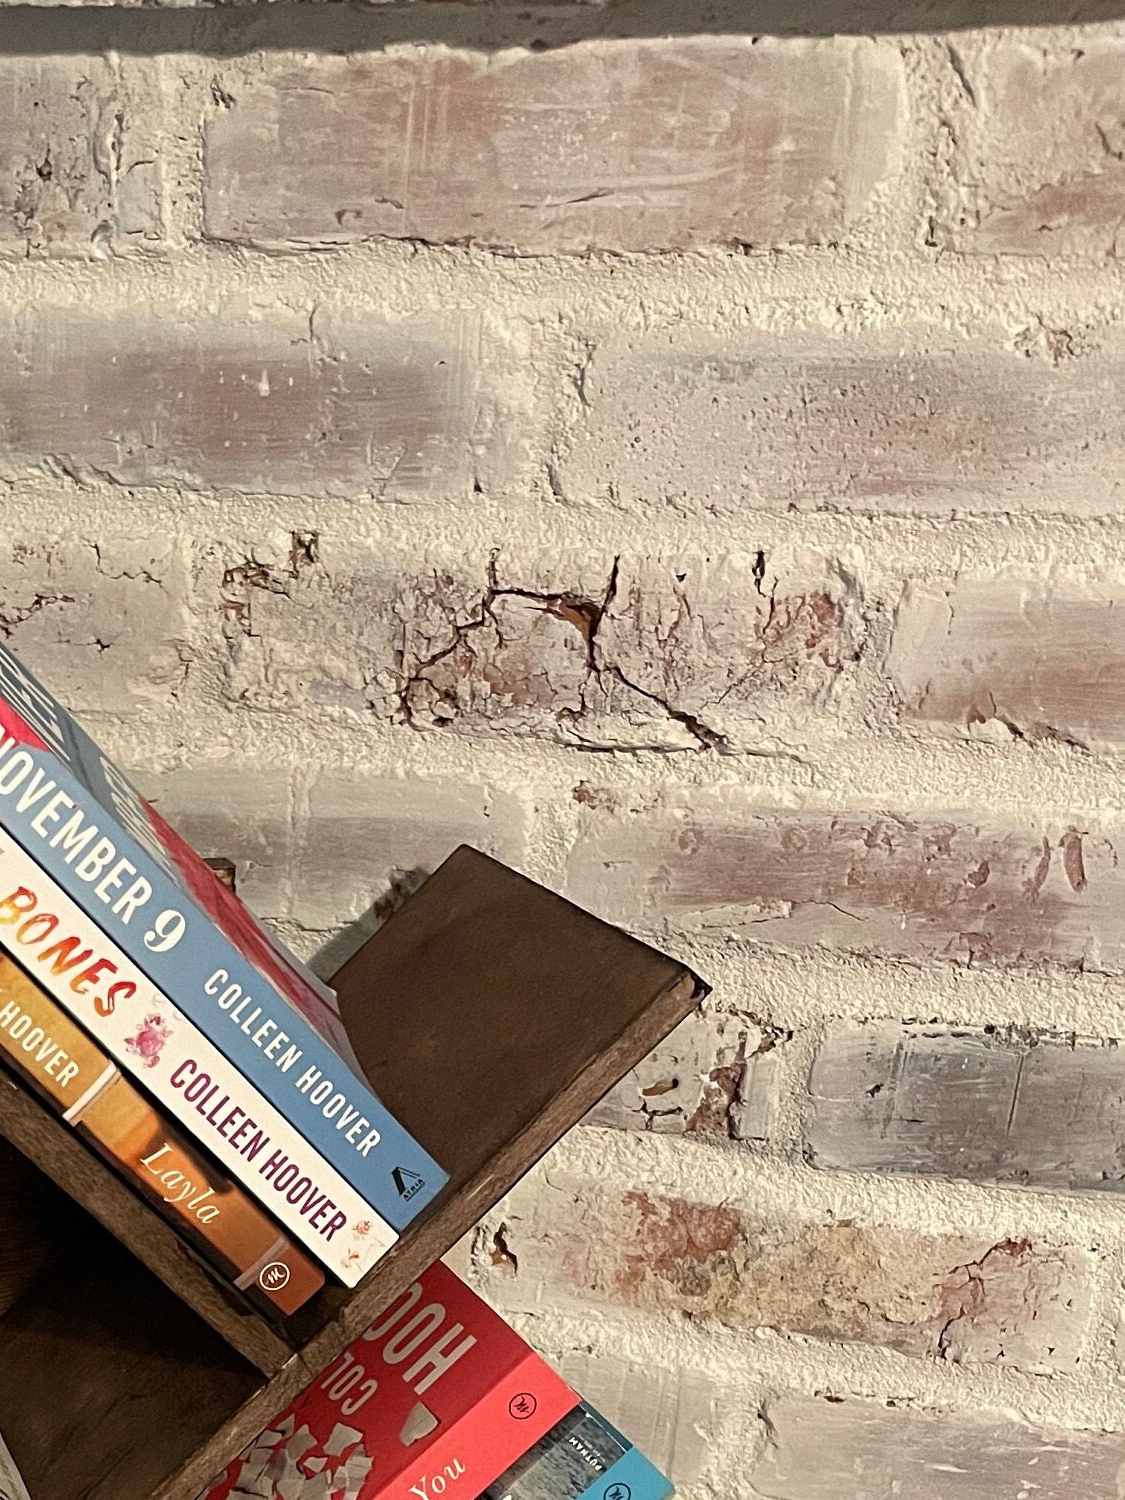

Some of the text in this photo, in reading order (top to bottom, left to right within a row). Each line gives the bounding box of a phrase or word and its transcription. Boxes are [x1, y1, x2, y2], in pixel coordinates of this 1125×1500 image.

[144, 909, 186, 953] 9
[204, 969, 381, 1158] COLLEEN HOOVER
[170, 1059, 347, 1242] COLLEEN HOOVER
[140, 1142, 221, 1225] Layla
[402, 1177, 423, 1199] ATRIA
[568, 1436, 603, 1471] PUTNAM
